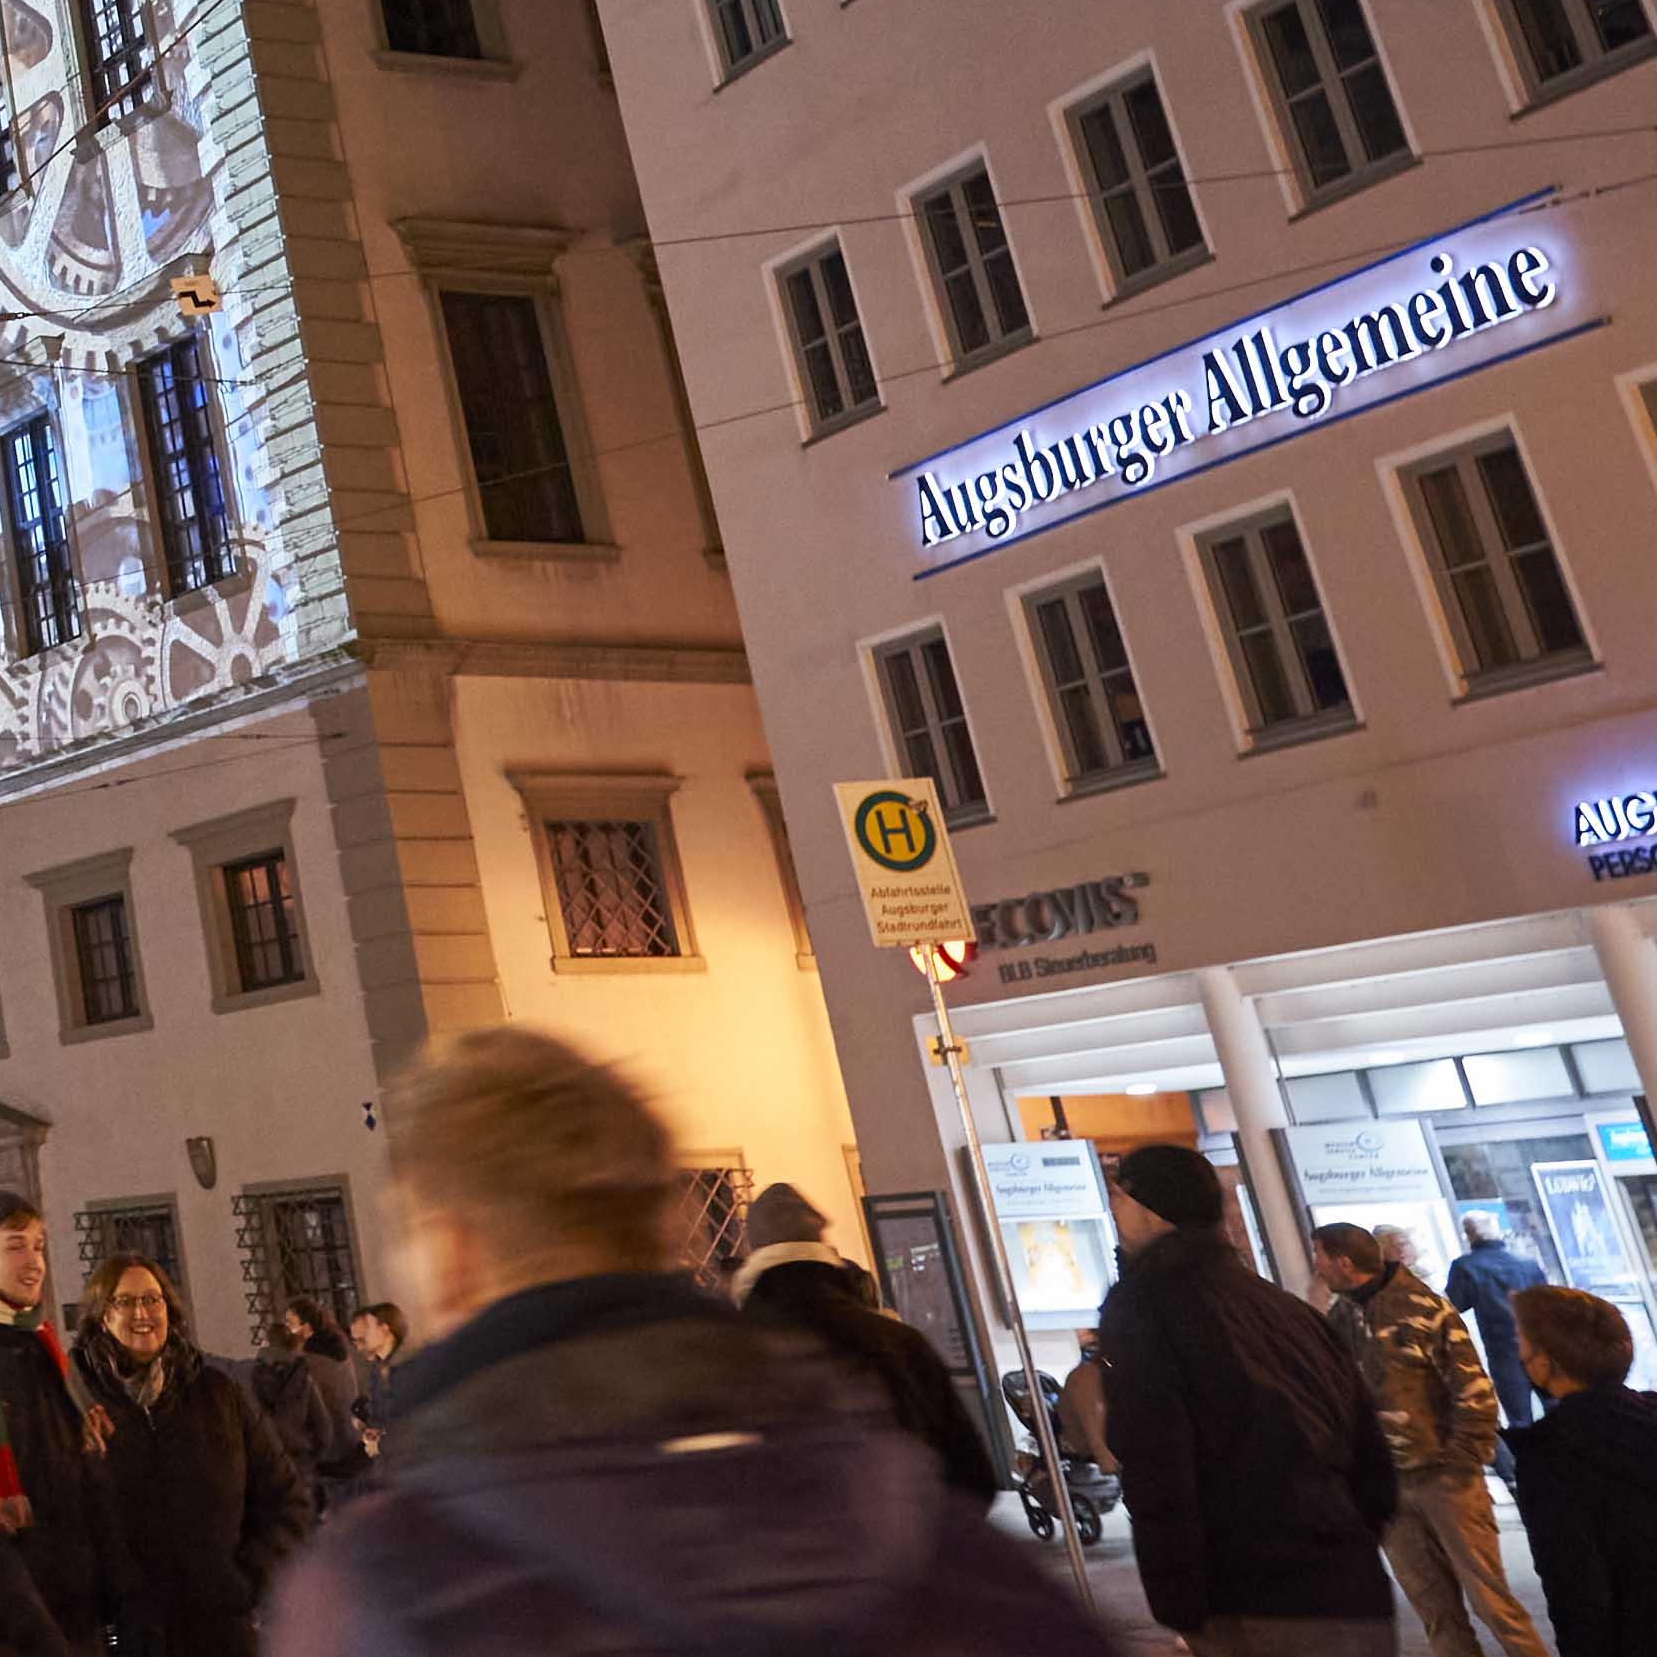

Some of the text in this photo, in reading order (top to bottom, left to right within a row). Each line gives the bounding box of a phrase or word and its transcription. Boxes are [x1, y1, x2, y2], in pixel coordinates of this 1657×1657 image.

[917, 245, 1556, 547] Augsburger Allgemeine
[875, 808, 916, 855] H
[1574, 790, 1657, 847] AUG
[870, 882, 952, 900] Abfahrtsstelle
[881, 901, 949, 918] Augsburger
[876, 918, 963, 935] Stadtrundfahrt
